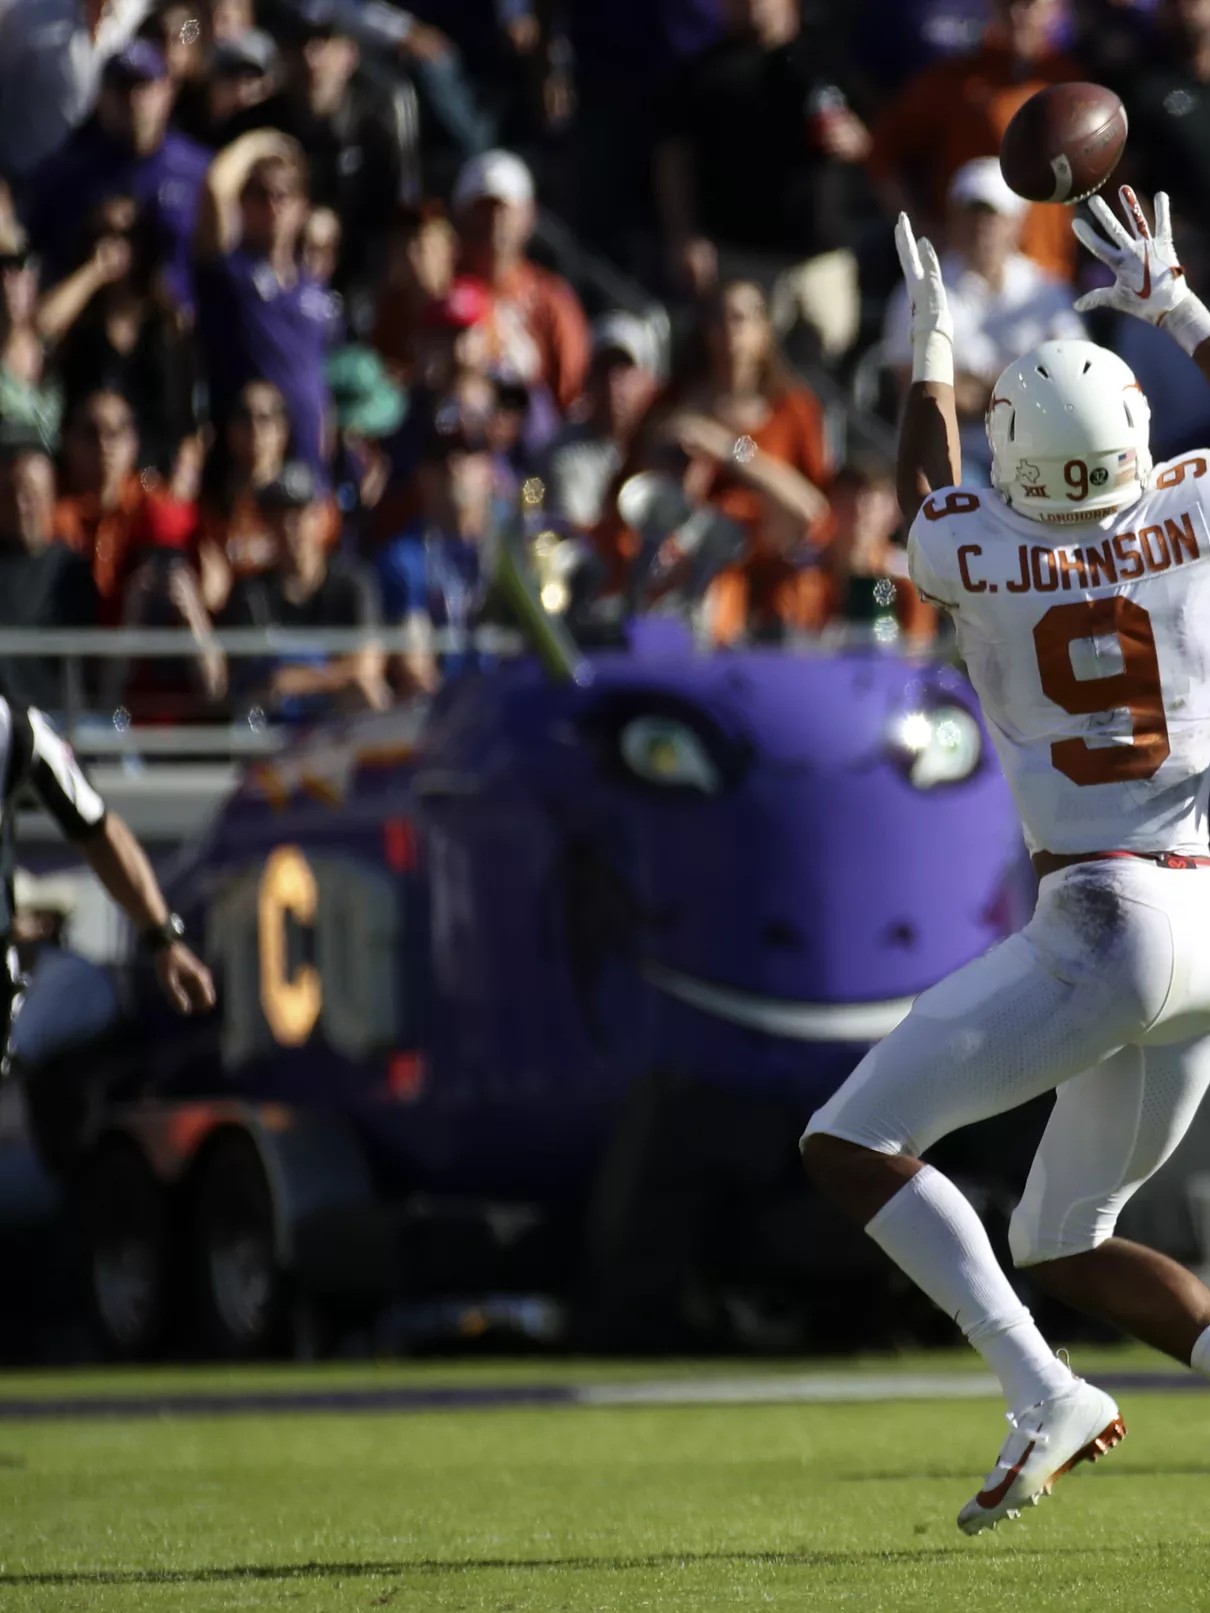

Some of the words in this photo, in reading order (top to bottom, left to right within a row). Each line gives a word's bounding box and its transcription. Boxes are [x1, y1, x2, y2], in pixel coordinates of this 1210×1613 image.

[1064, 459, 1089, 502] 9
[1155, 456, 1208, 491] 9
[922, 492, 981, 522] 9
[1032, 595, 1171, 787] 9
